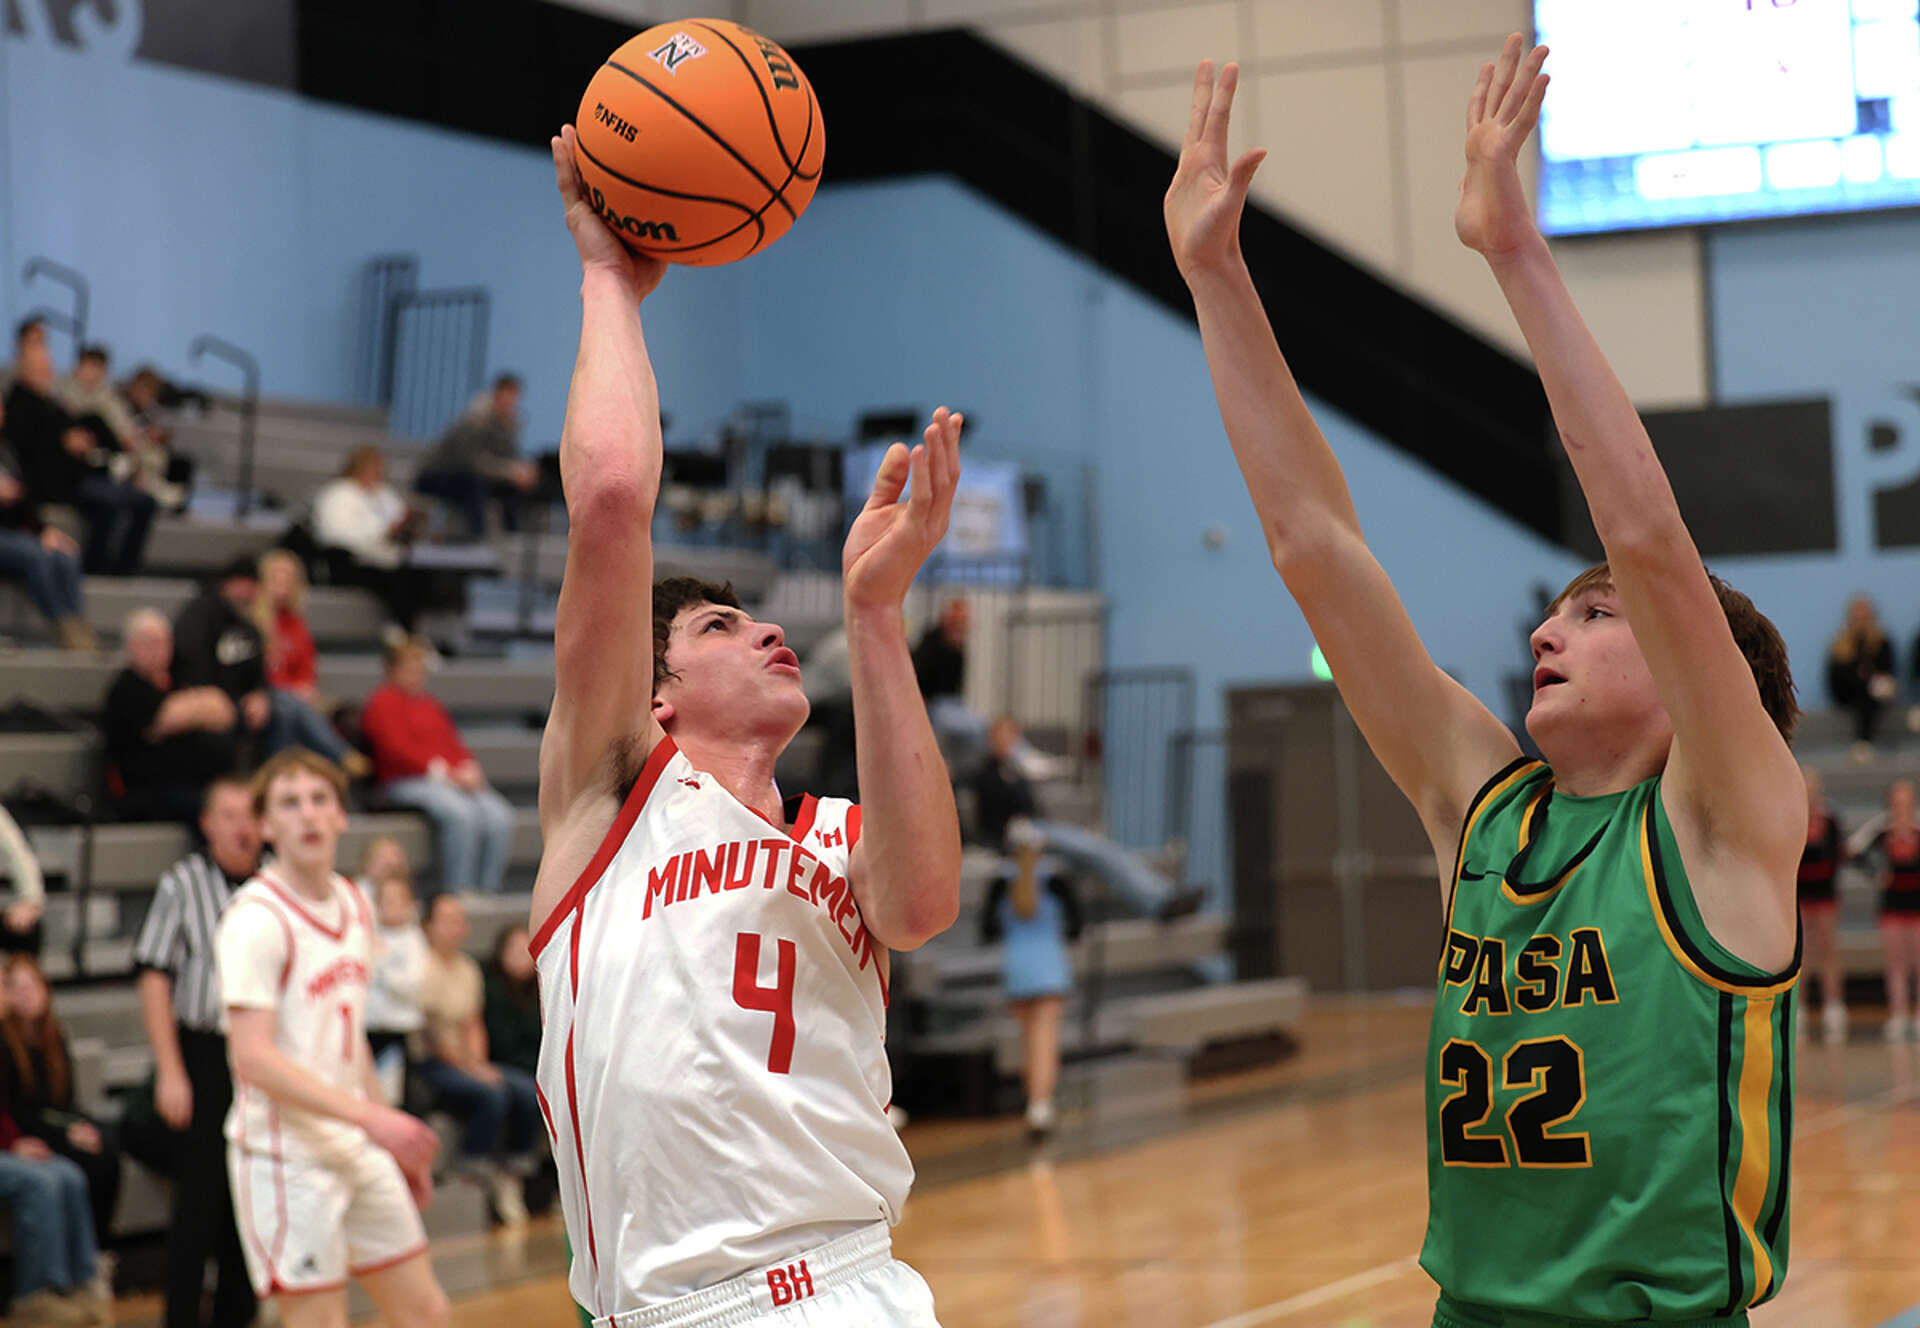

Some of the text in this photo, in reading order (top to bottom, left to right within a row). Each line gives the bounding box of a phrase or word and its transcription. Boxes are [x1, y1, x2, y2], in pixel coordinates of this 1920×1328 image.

[600, 108, 638, 143] NFHS
[732, 932, 796, 1075] 4
[1444, 926, 1620, 1016] PASA
[1440, 1034, 1593, 1168] 22
[766, 1259, 814, 1307] BH
